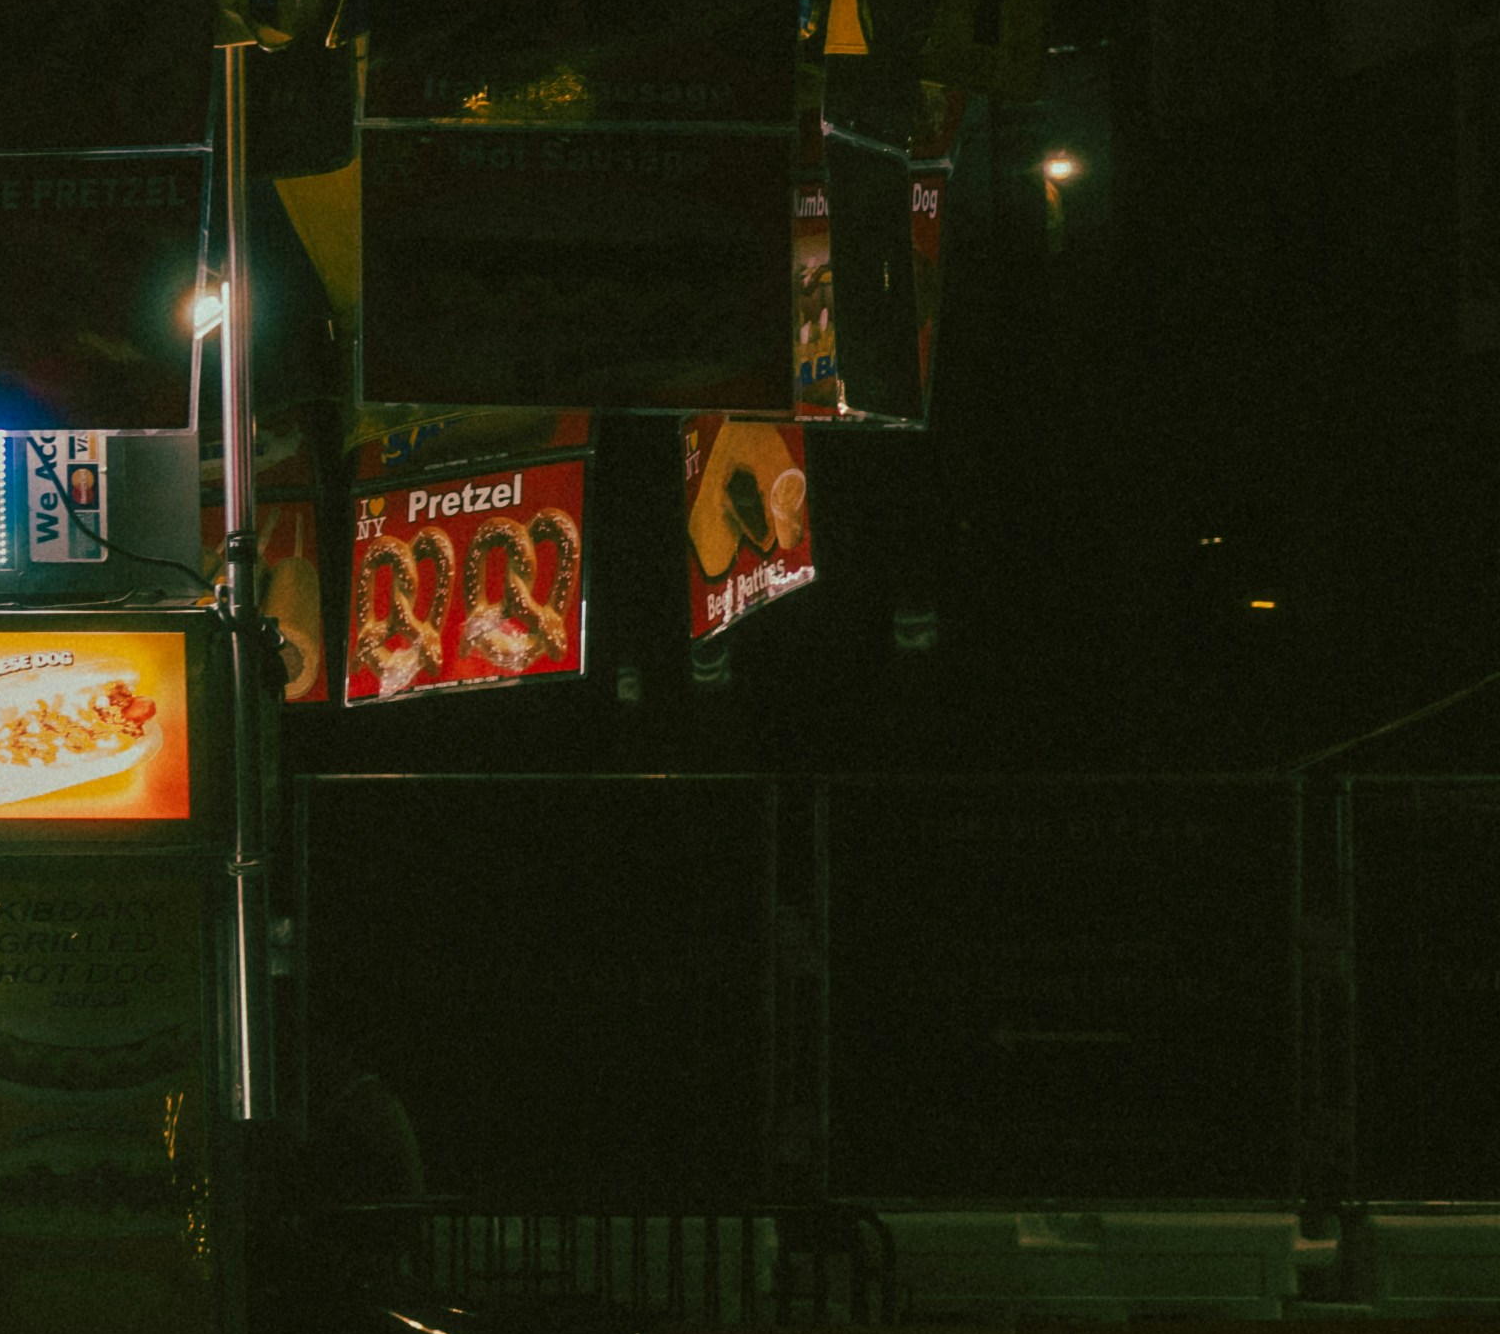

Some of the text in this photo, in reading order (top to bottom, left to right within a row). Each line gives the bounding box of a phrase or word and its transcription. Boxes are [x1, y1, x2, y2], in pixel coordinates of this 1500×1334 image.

[33, 175, 186, 210] PRETZEL
[797, 188, 829, 218] umb
[912, 183, 938, 218] Dog
[408, 473, 522, 524] Pretzel
[35, 492, 59, 544] We
[356, 517, 387, 540] NY
[33, 650, 74, 667] DOG
